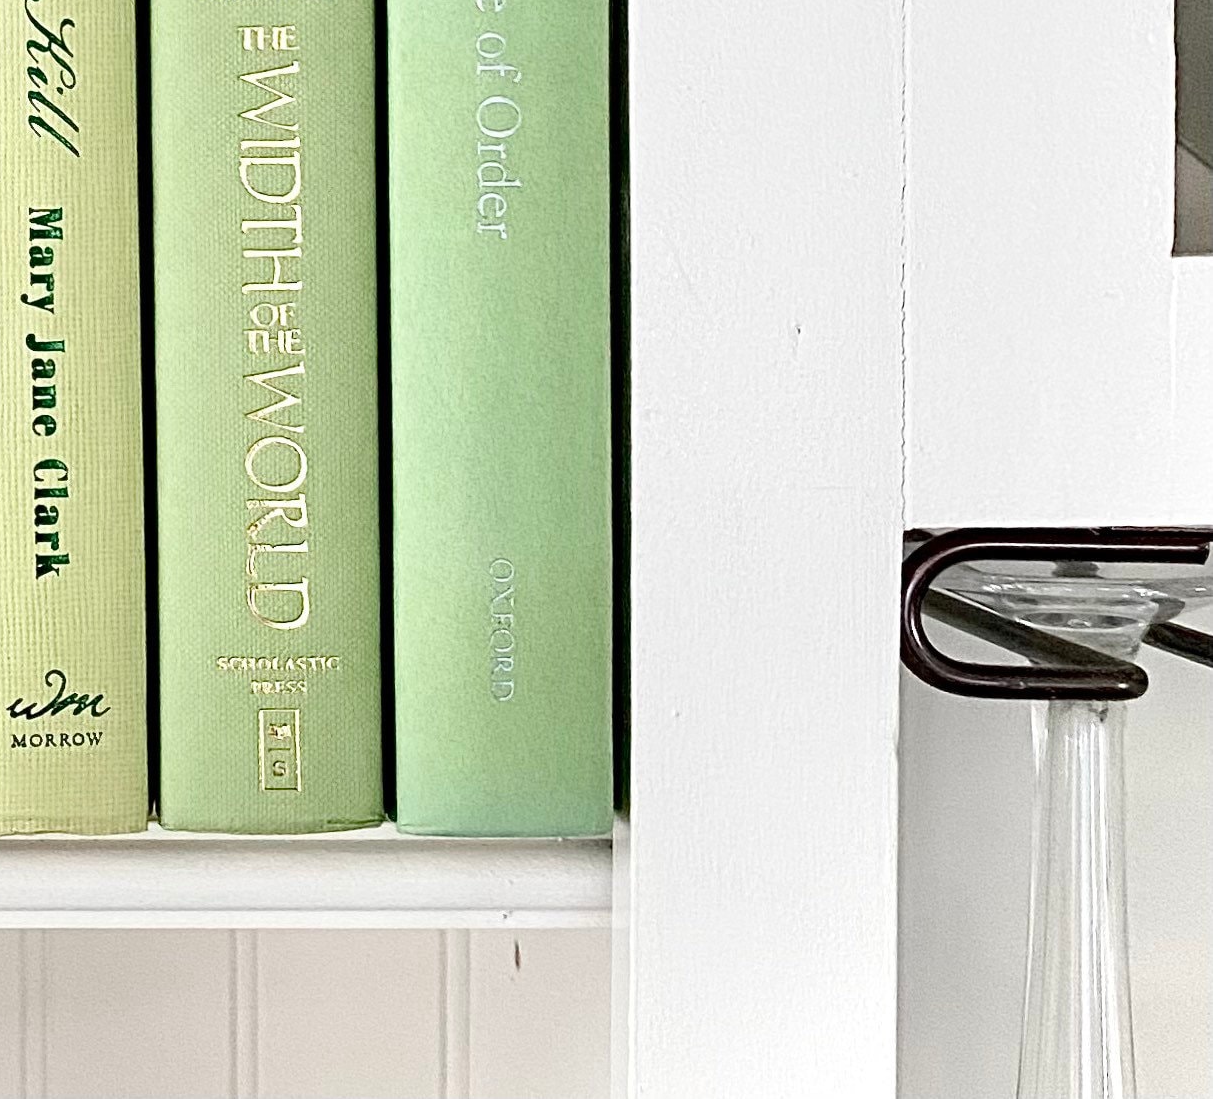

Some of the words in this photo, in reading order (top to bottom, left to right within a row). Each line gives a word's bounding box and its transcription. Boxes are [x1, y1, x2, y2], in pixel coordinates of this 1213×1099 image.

[238, 25, 300, 52] THE
[475, 31, 522, 83] of
[238, 61, 304, 295] WIDTH
[476, 95, 522, 240] Order
[20, 206, 64, 316] Mary
[243, 328, 304, 356] THE
[250, 301, 297, 330] OF
[24, 334, 65, 437] Jane
[32, 458, 72, 581] Clark
[242, 361, 310, 632] WORLD
[216, 656, 341, 672] SCHOLASTIC
[488, 557, 515, 702] OXFORD
[250, 679, 308, 696] PRESS
[11, 731, 104, 748] MORROW
